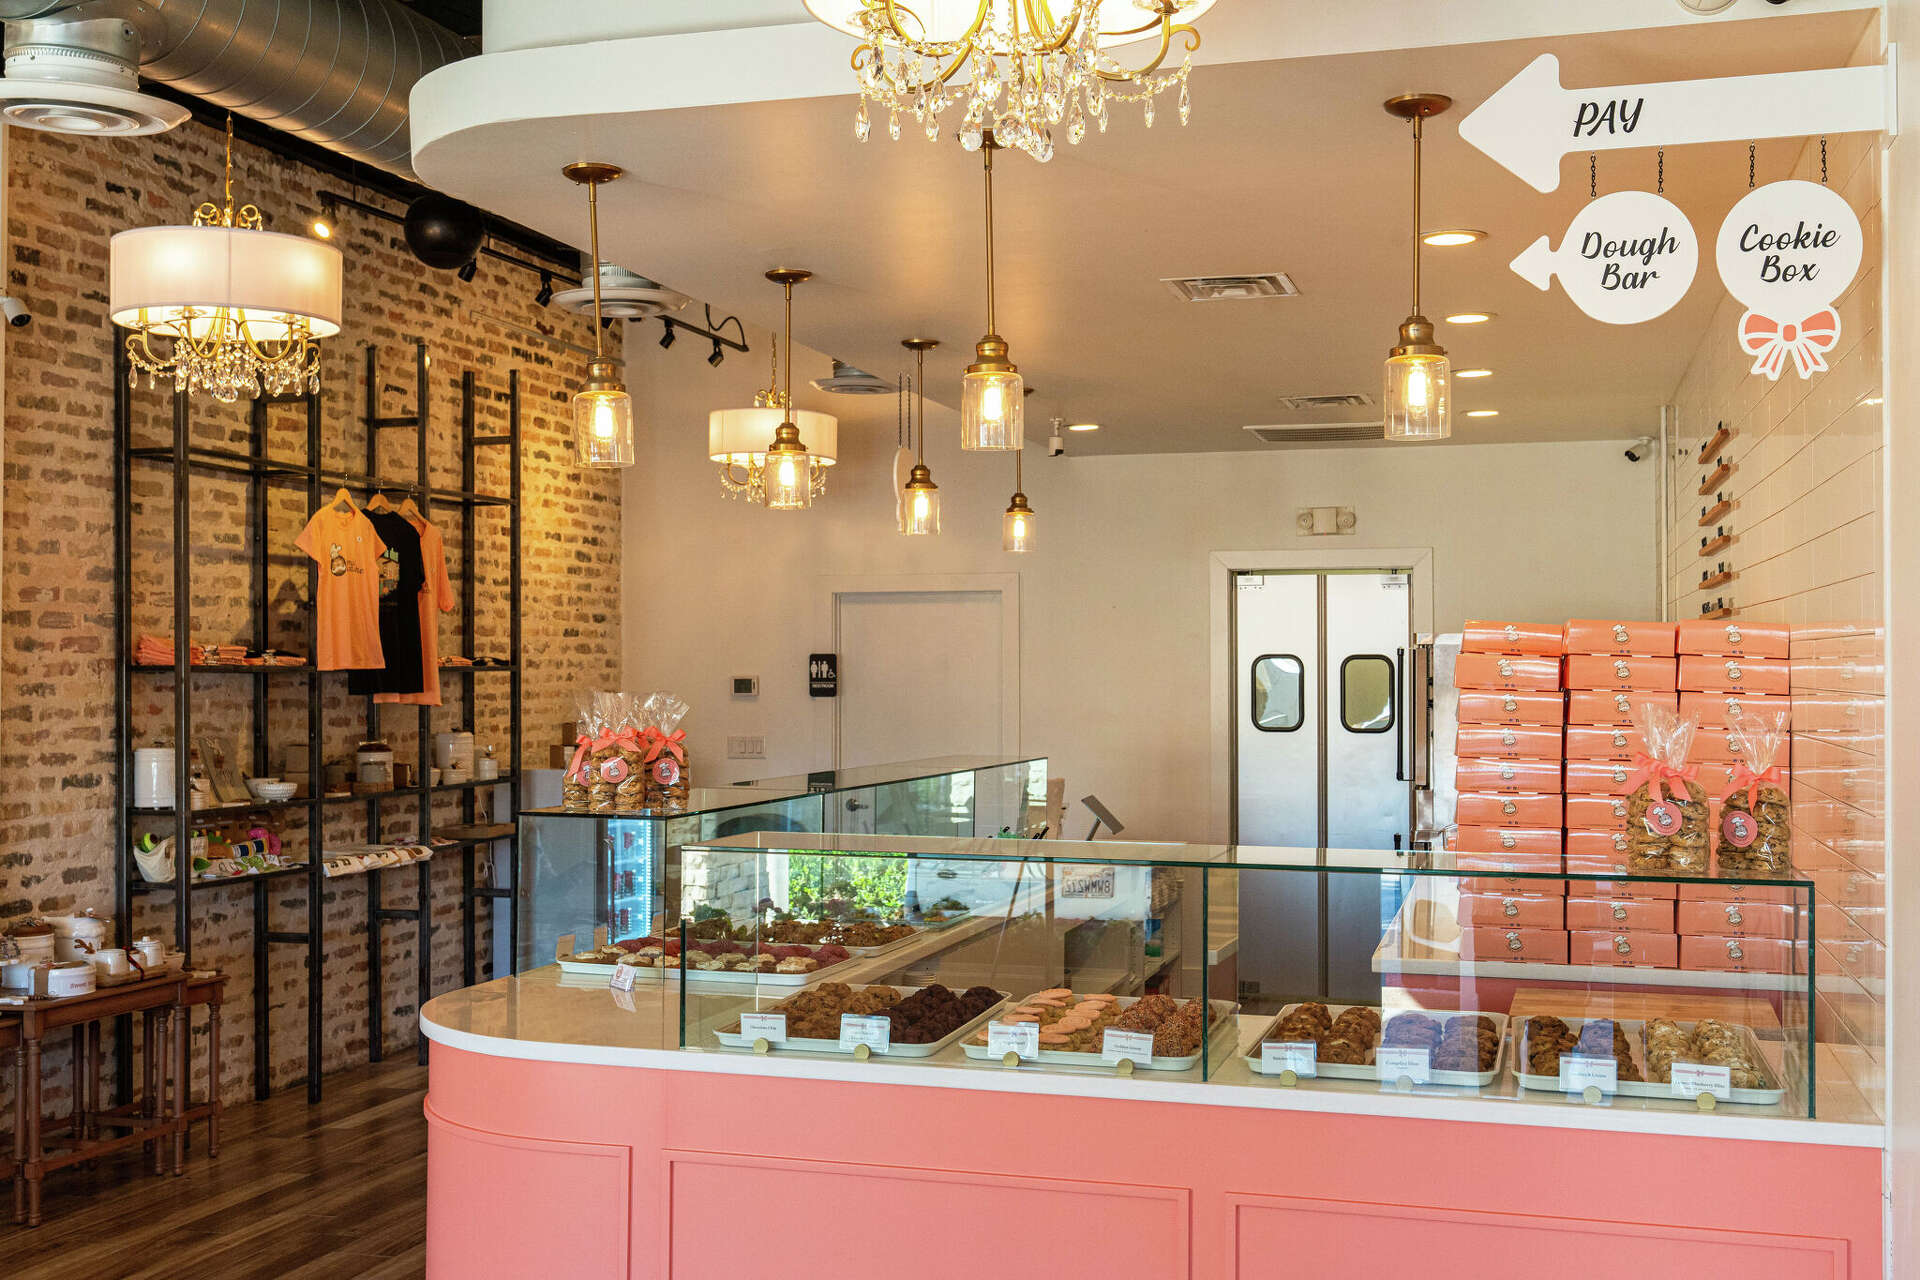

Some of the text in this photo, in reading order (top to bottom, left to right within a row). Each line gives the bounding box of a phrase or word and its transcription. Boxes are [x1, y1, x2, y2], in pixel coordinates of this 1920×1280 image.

[1573, 98, 1644, 137] PAY
[1581, 227, 1680, 265] Dough
[1740, 221, 1841, 252] Cookie
[1601, 263, 1660, 290] Bar
[1761, 255, 1820, 282] Box
